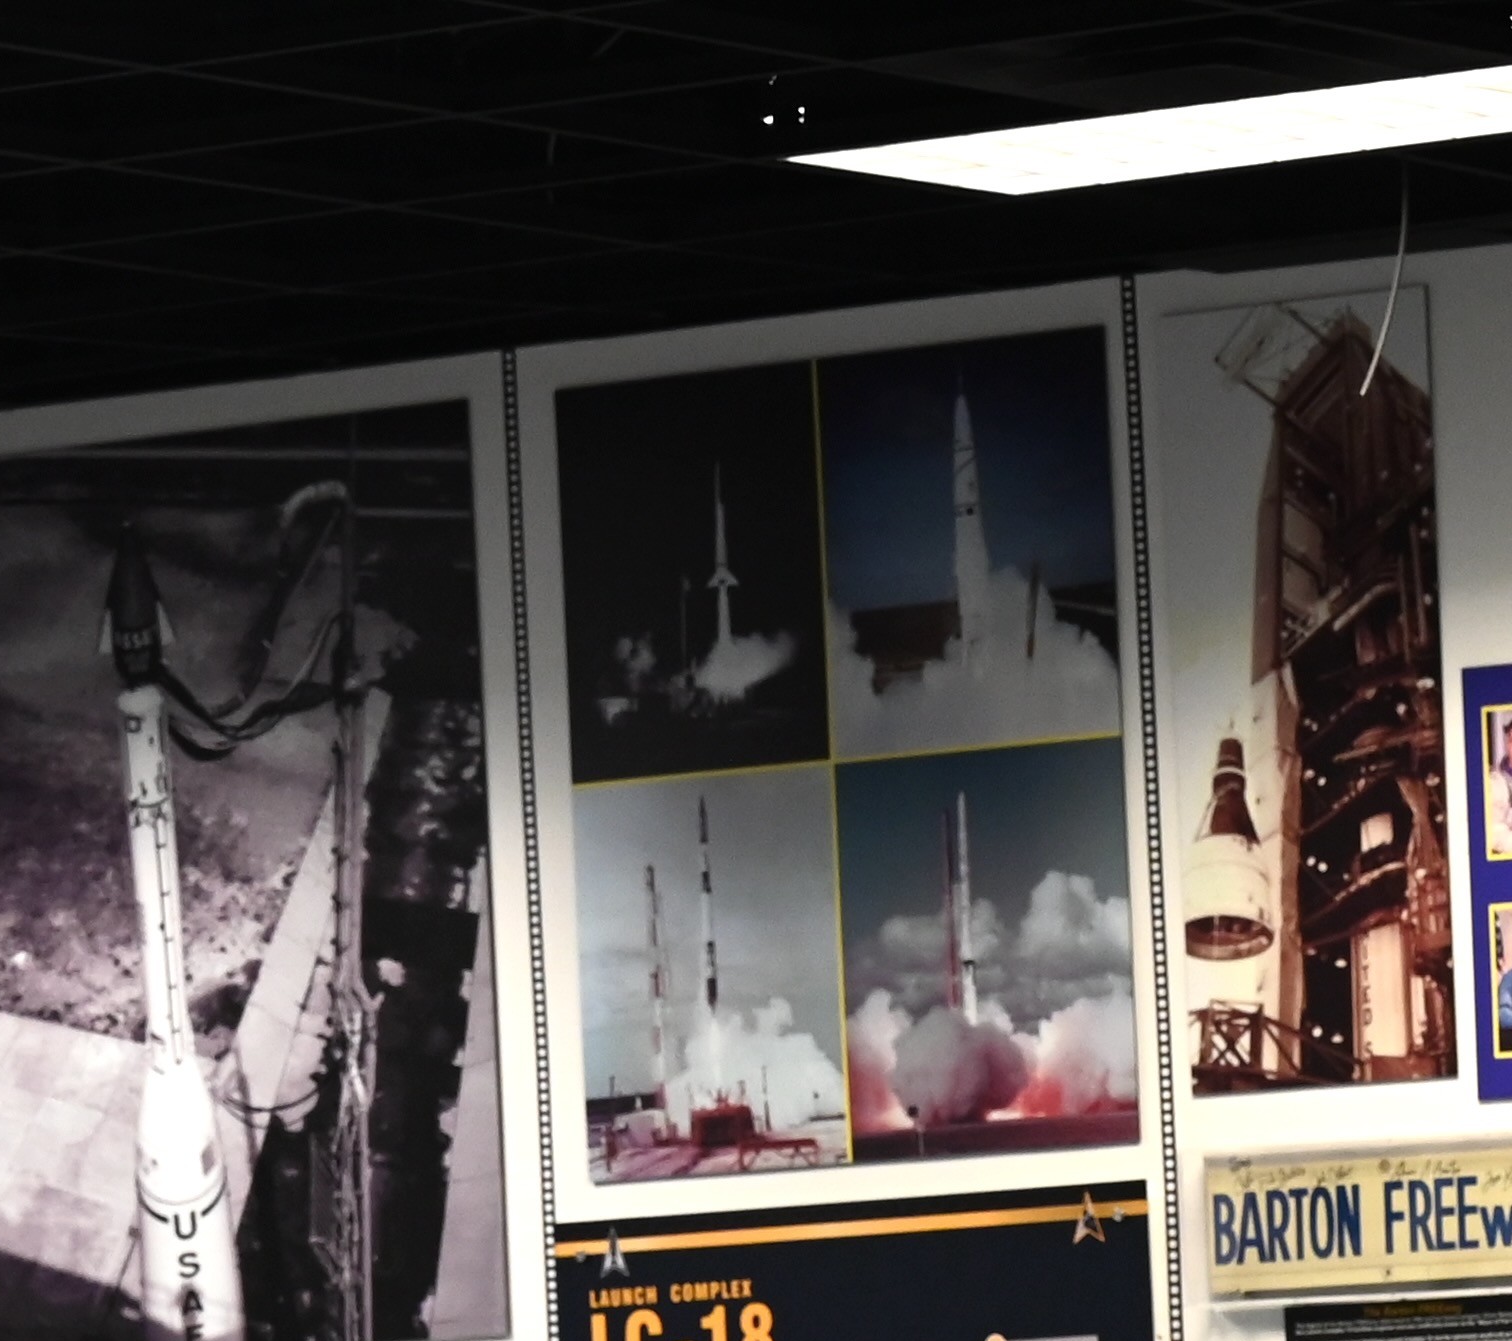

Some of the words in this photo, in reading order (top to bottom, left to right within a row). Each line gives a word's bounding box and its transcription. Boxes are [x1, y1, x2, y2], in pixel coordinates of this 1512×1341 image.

[1212, 1184, 1362, 1266] BARTON
[589, 1286, 658, 1309] LAUNCH
[669, 1278, 753, 1304] COMPLEX
